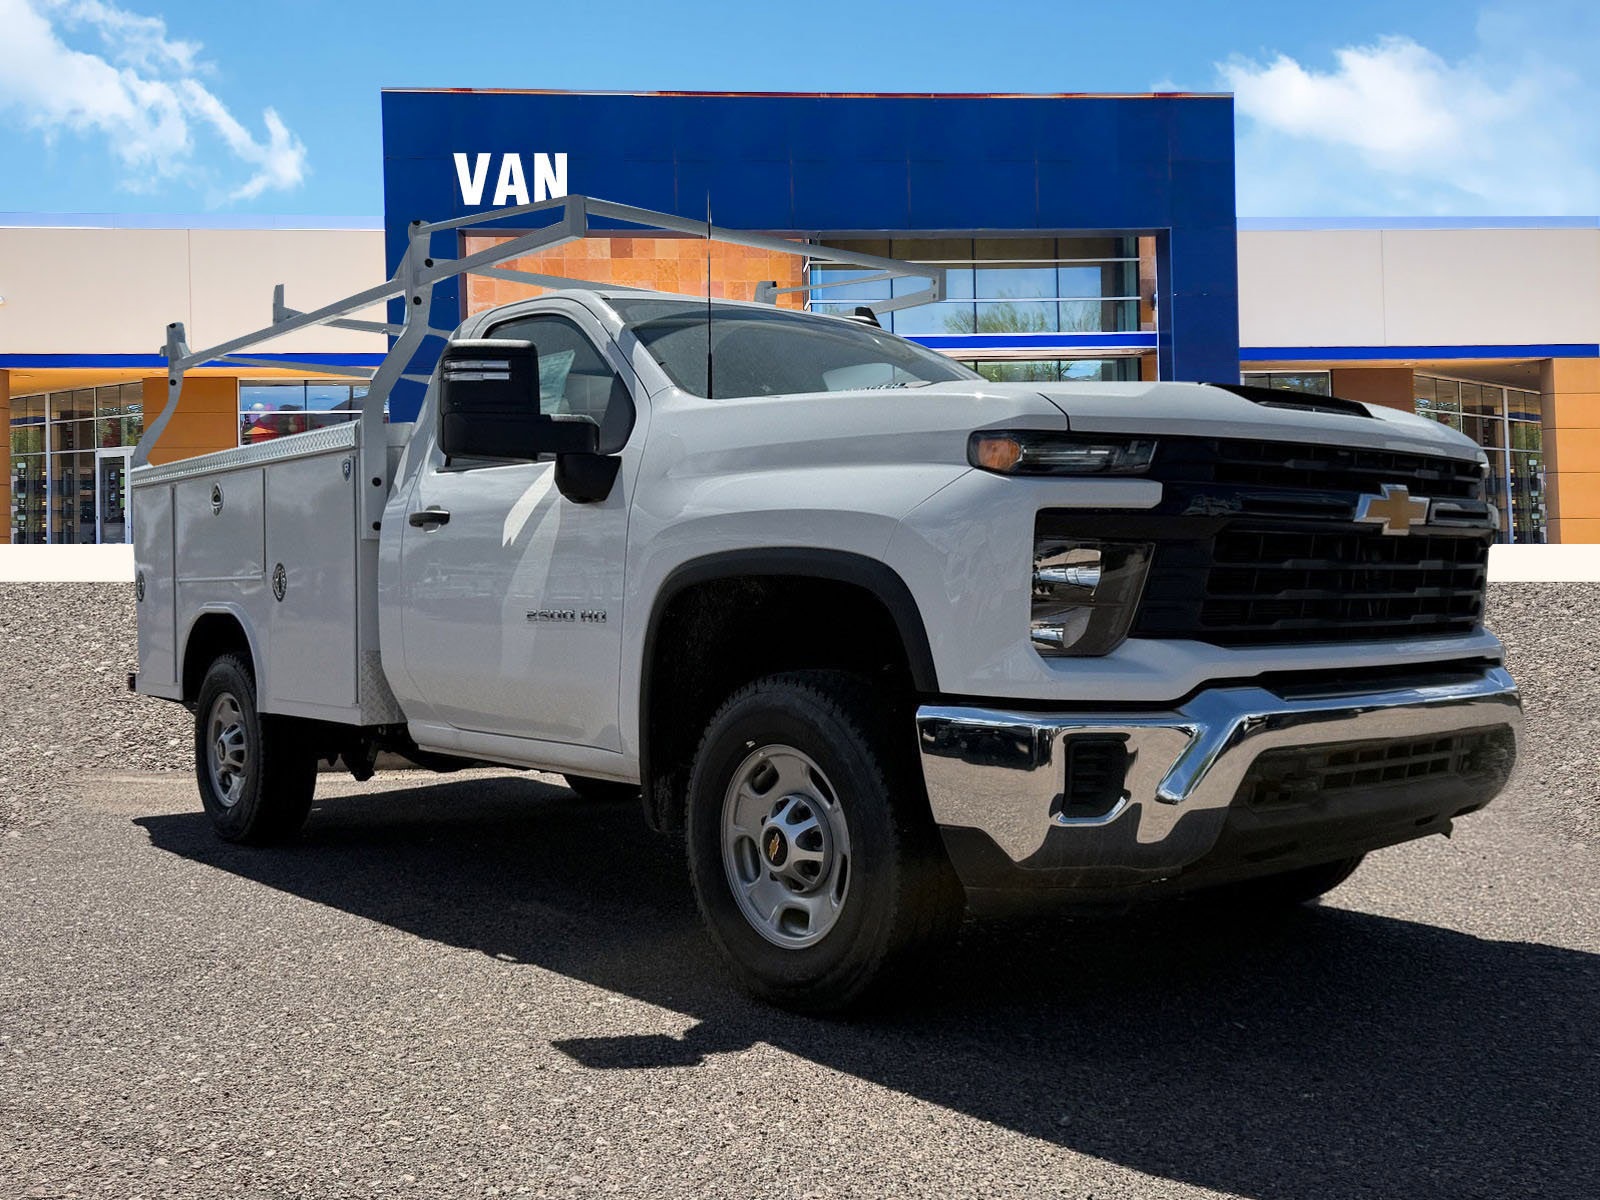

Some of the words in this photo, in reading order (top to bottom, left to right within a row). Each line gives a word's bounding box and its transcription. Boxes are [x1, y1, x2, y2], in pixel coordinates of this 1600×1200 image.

[453, 153, 568, 205] VAN
[526, 609, 576, 622] 2500
[580, 610, 607, 623] HD
